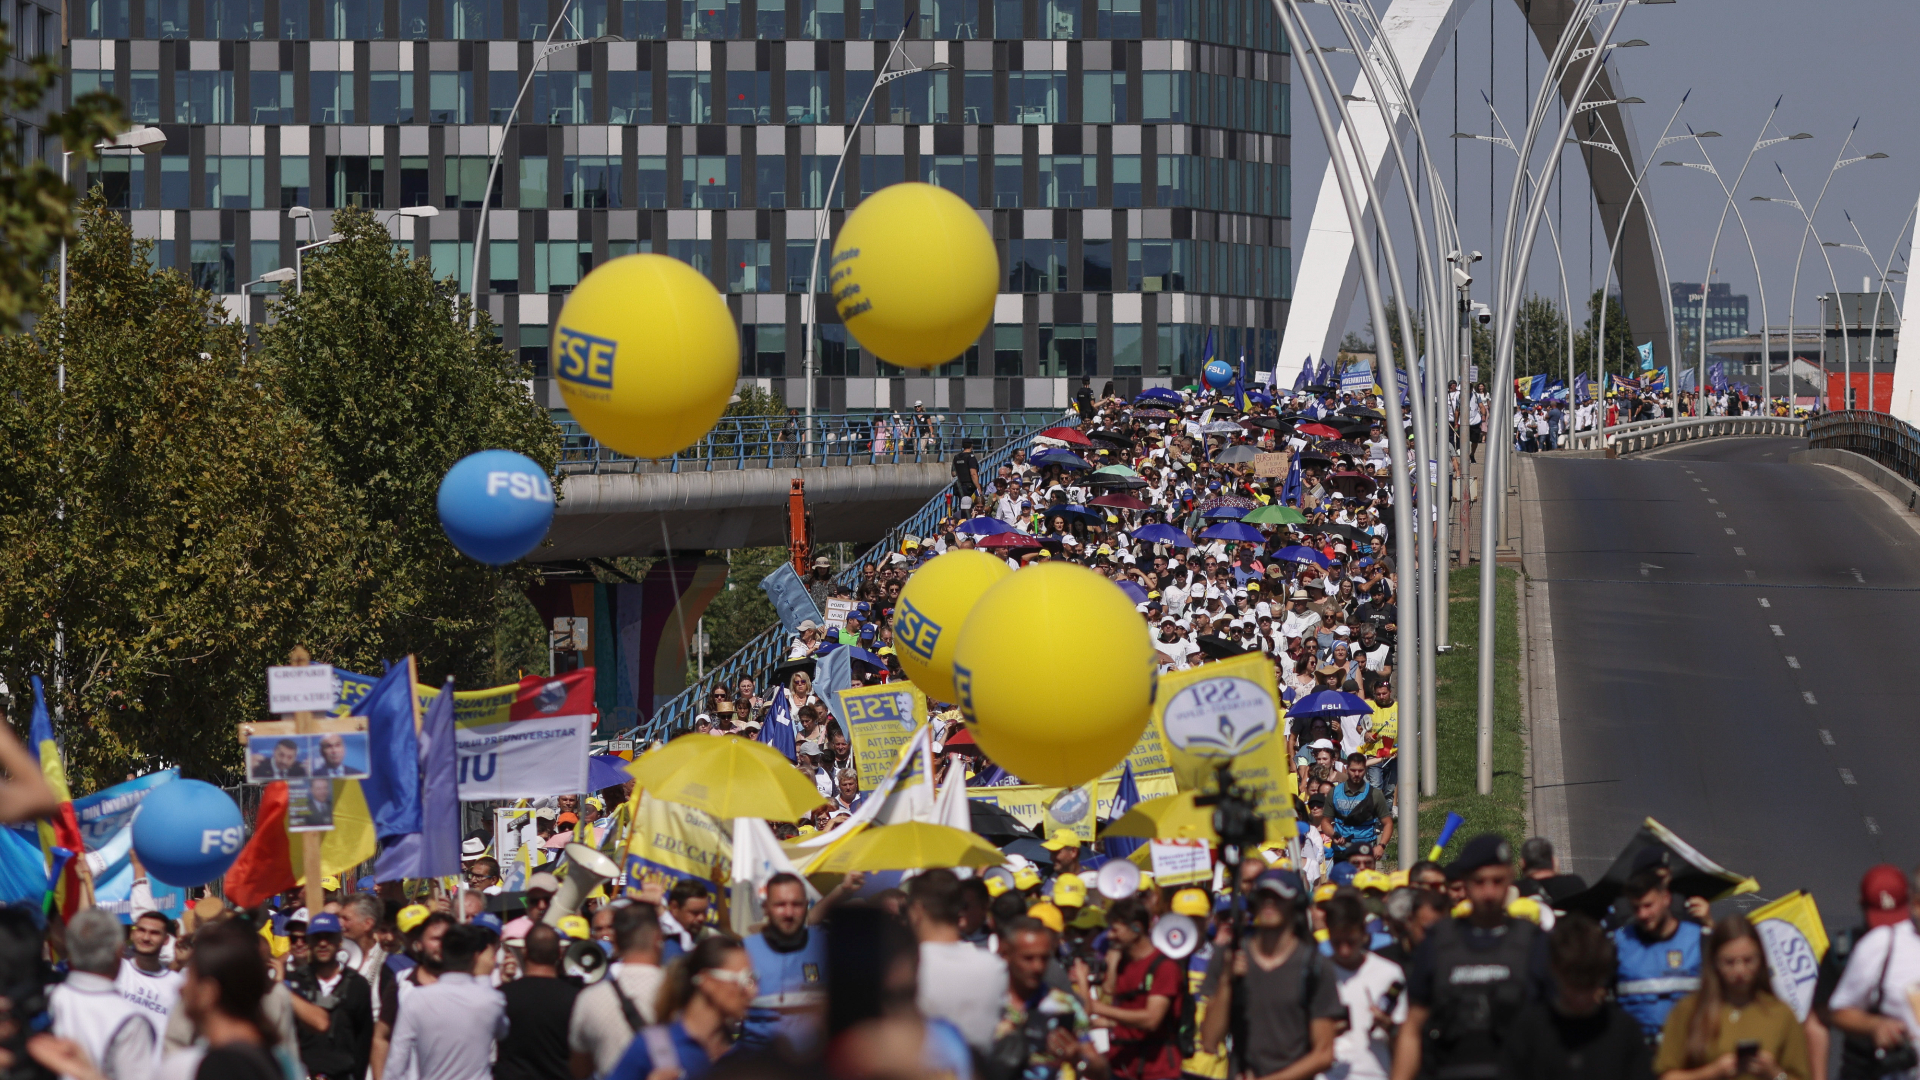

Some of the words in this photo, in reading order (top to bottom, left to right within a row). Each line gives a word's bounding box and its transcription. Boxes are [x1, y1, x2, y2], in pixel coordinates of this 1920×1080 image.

[557, 332, 614, 382] FSE
[1206, 365, 1227, 376] FSLI
[486, 471, 554, 502] FSLI
[895, 604, 938, 654] FSE
[1781, 937, 1819, 986] SSI
[123, 990, 167, 1015] VRANCEA
